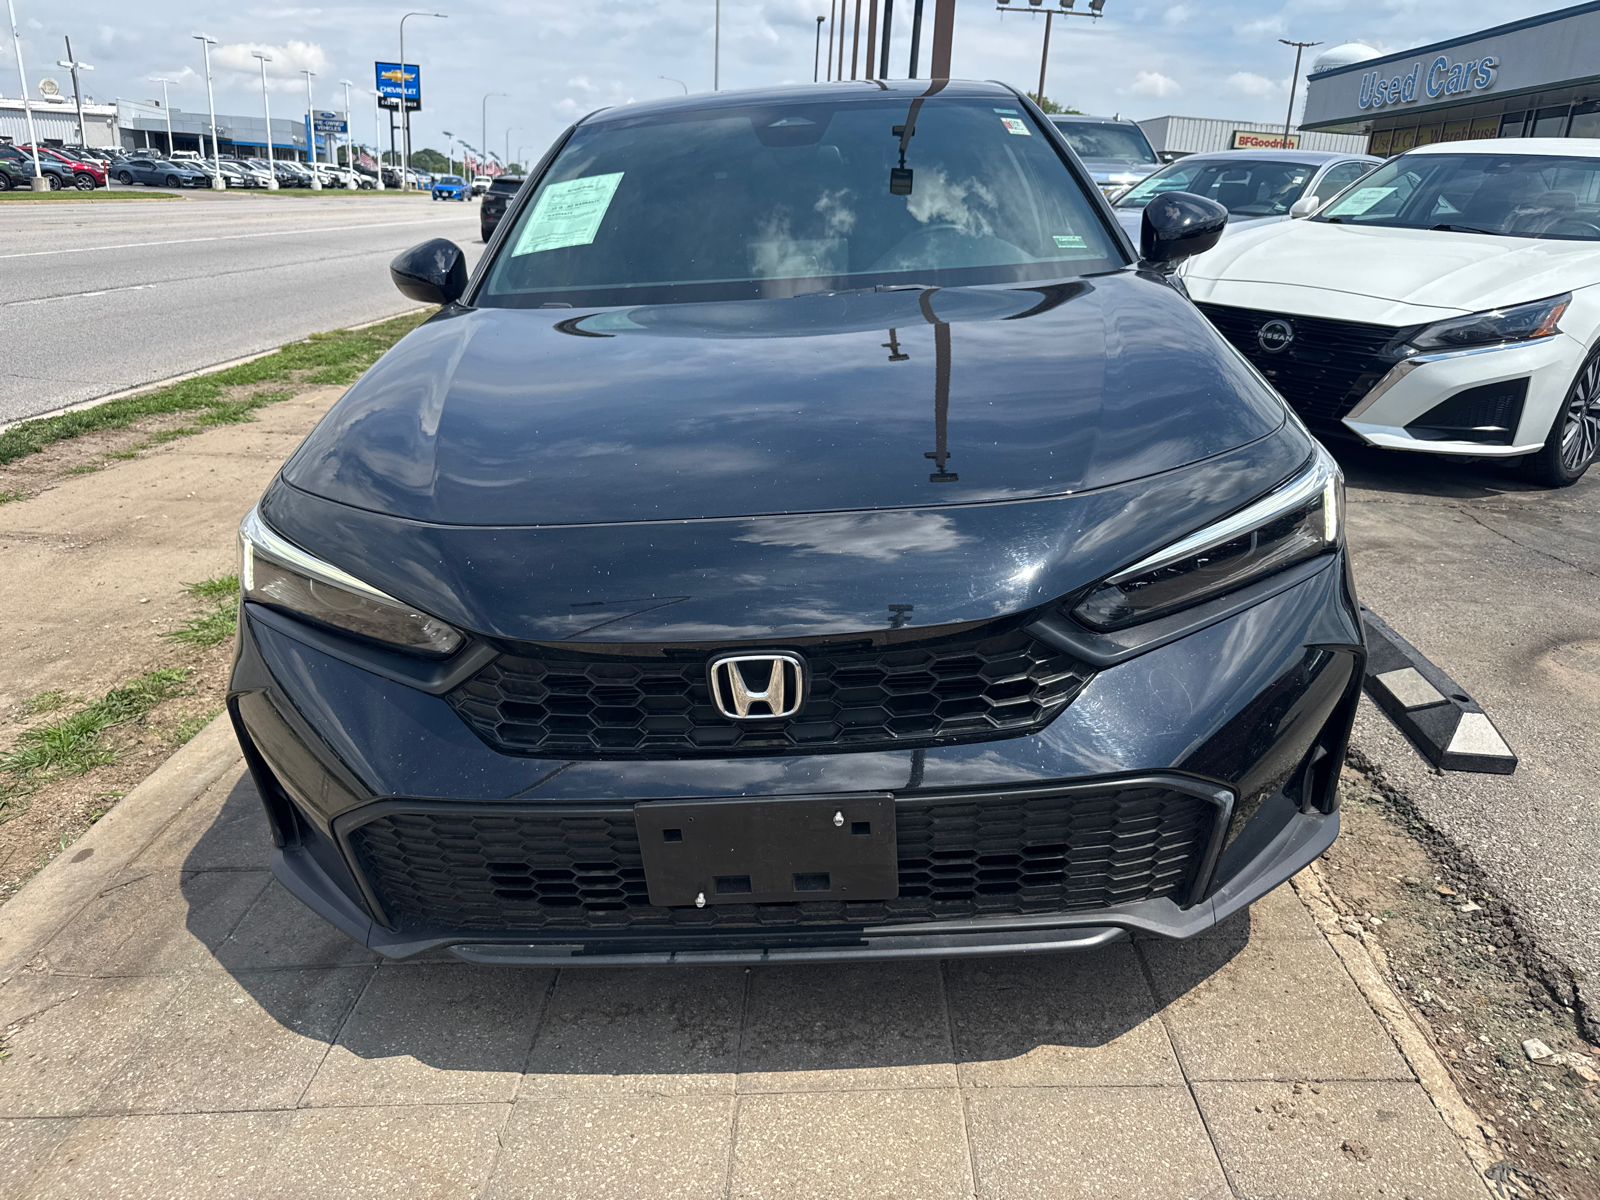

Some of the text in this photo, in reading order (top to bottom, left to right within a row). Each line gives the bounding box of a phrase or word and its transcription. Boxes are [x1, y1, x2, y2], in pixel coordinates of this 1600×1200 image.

[1358, 55, 1498, 110] Used Cars
[1373, 133, 1400, 150] Used
[1257, 330, 1295, 342] NISSAN
